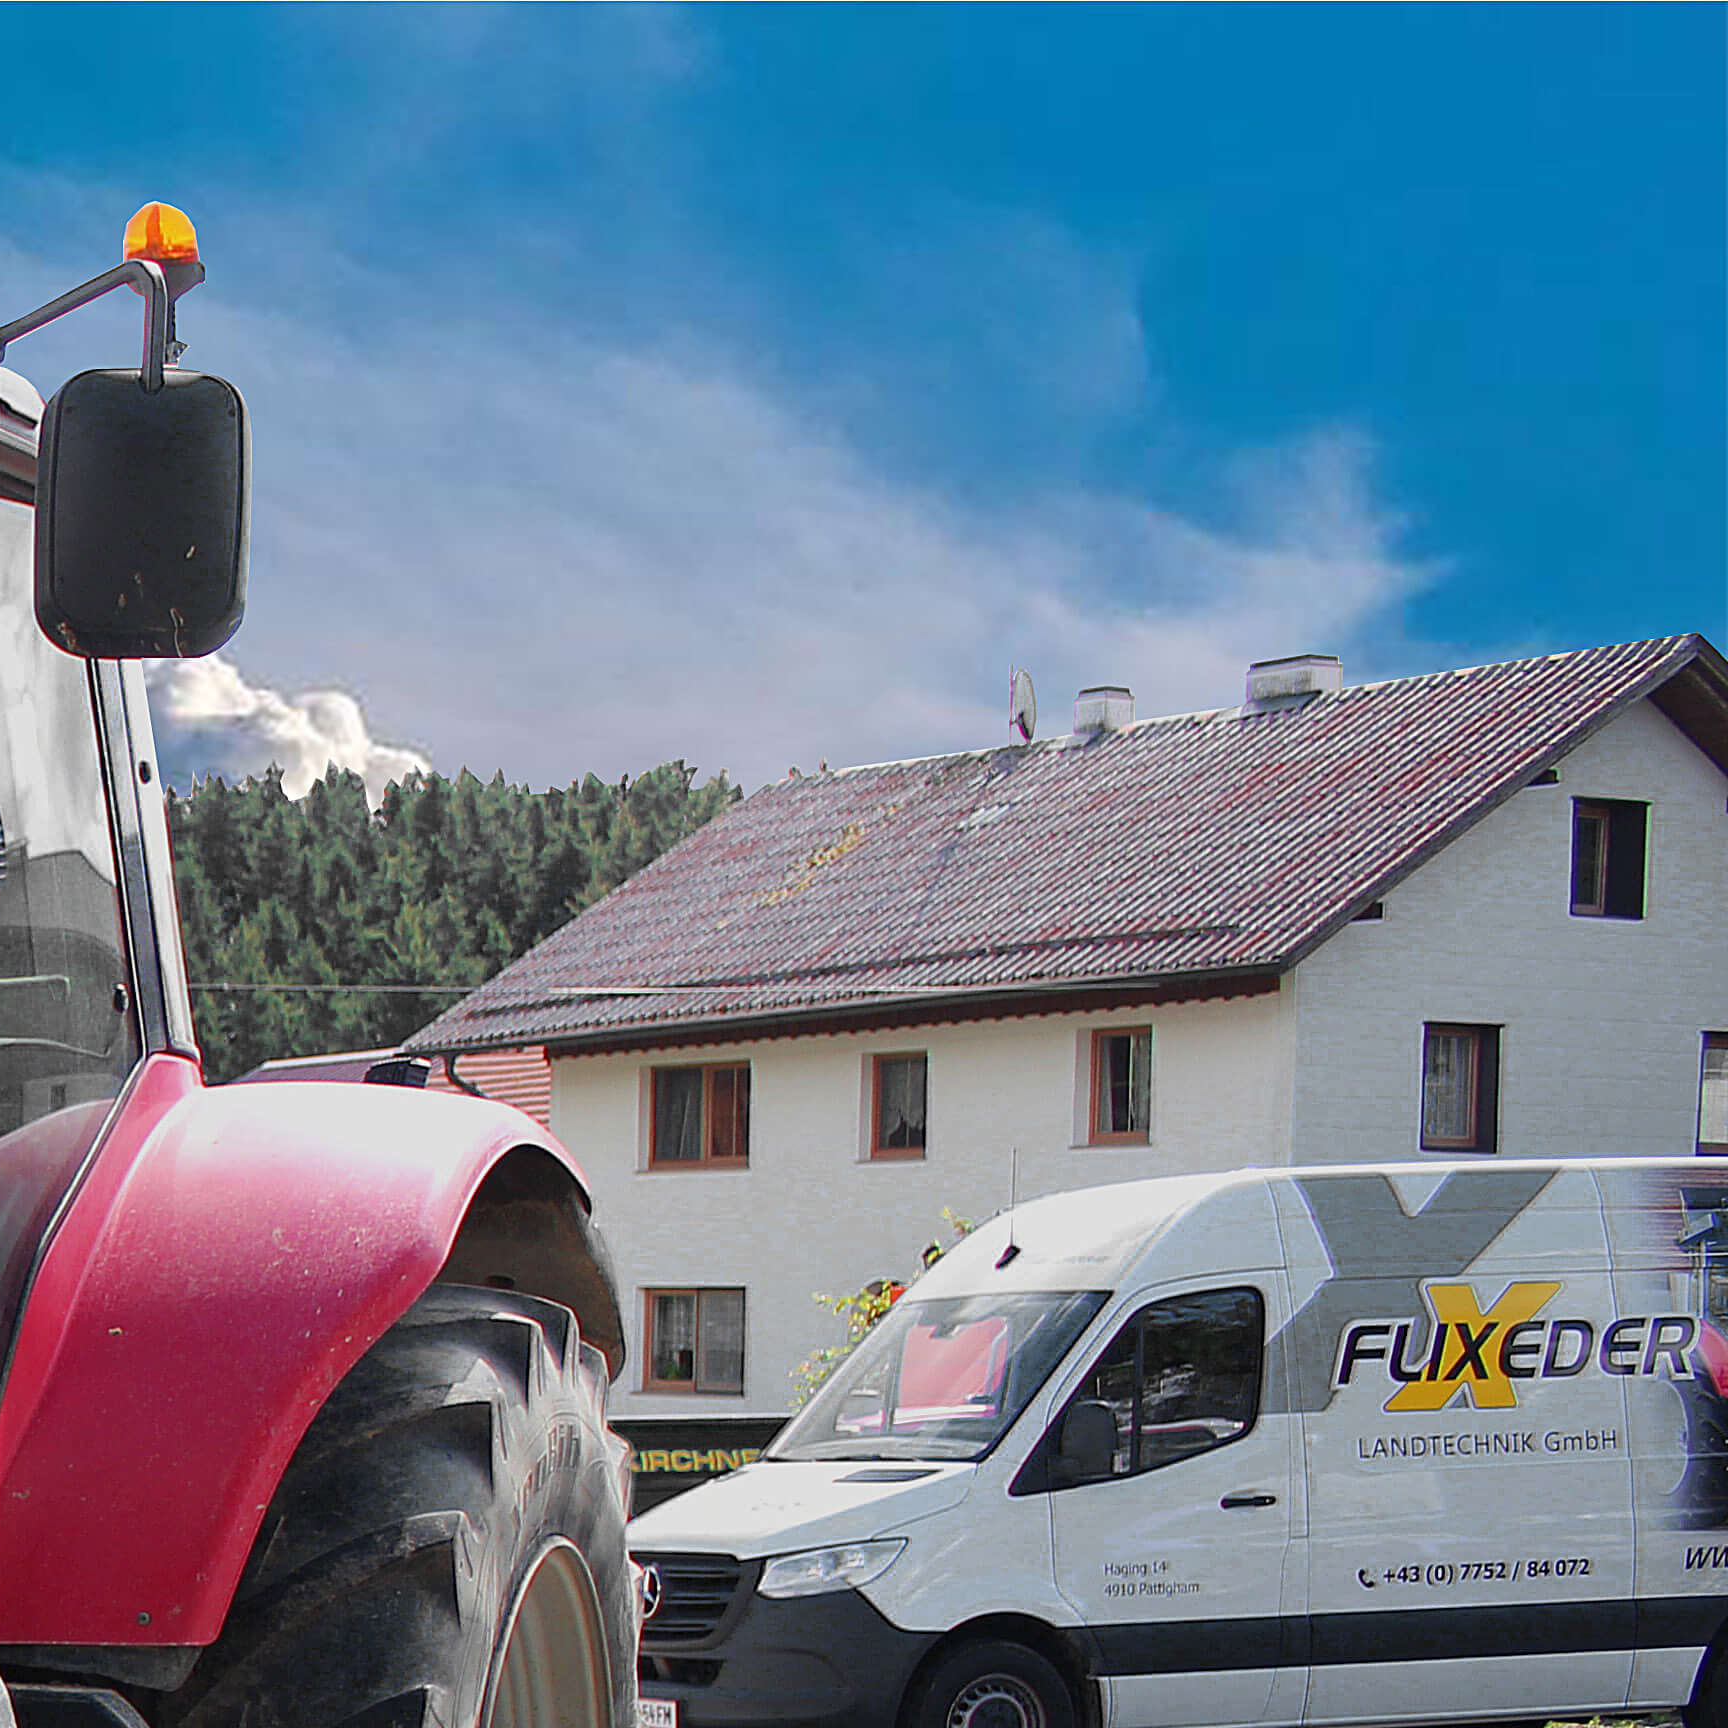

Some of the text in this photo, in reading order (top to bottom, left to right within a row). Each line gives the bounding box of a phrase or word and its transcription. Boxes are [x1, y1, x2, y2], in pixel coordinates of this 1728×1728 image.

[1358, 1429, 1618, 1459] LANDTECHNIK GmbH
[1382, 1558, 1591, 1586] +43 (0) 7752 / 84 072
[1104, 1582, 1136, 1597] 4910
